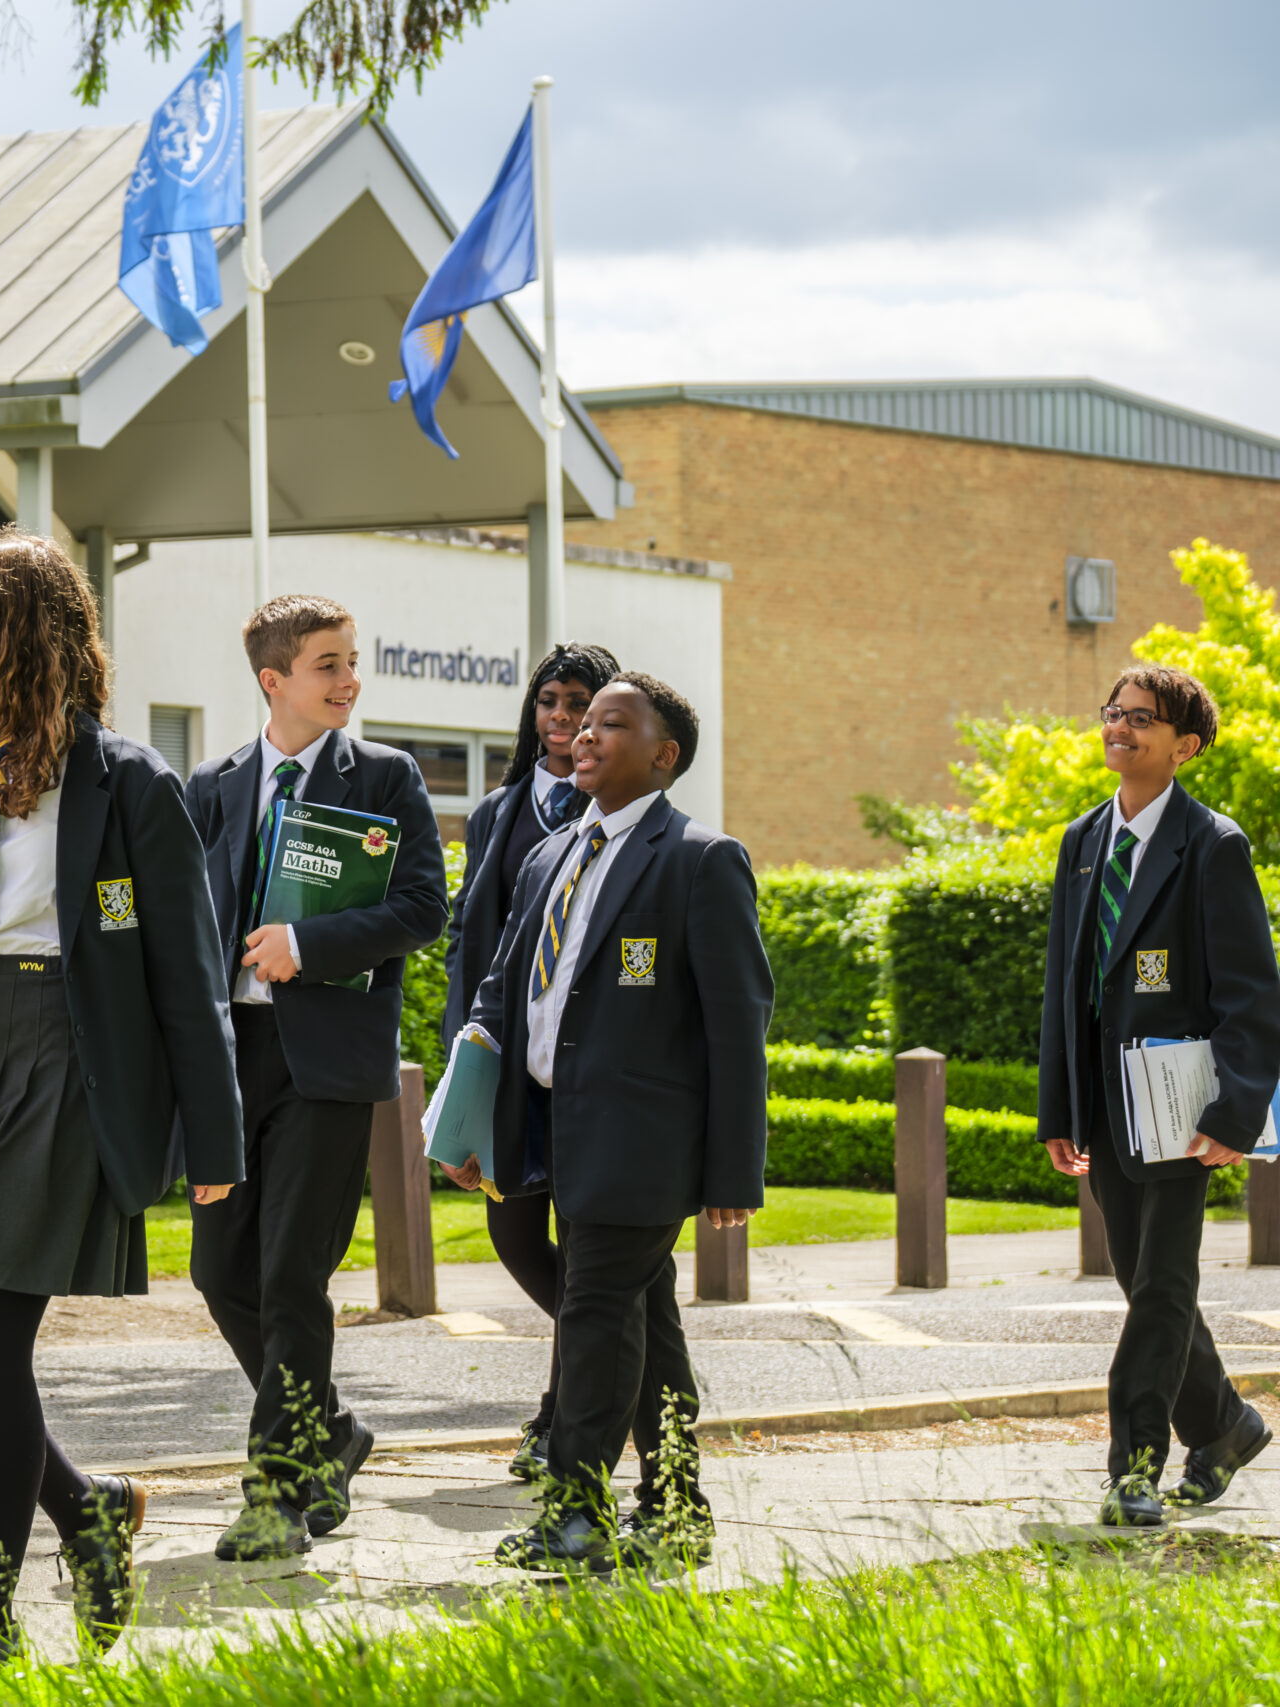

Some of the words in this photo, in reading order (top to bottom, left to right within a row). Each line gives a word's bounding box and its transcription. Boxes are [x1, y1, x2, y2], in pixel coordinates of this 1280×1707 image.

[376, 635, 519, 686] International
[292, 809, 311, 819] CGP
[286, 839, 314, 852] GCSE
[314, 845, 336, 857] AQA
[285, 852, 338, 876] Maths
[19, 961, 44, 972] WYM
